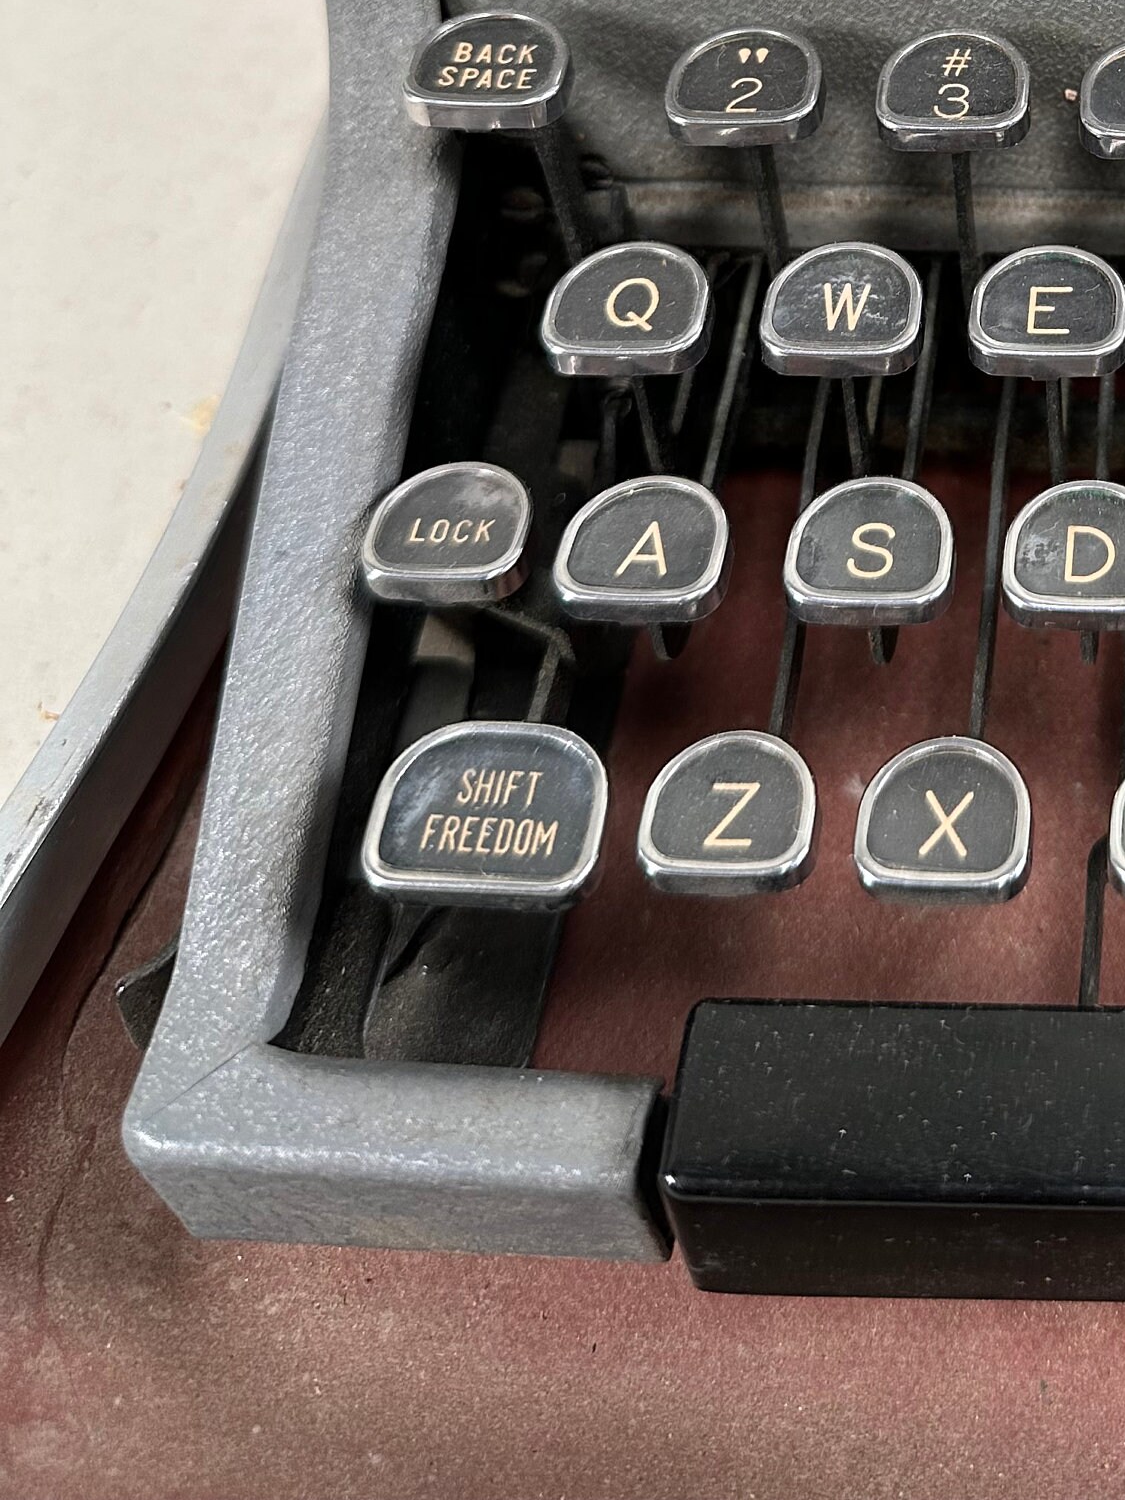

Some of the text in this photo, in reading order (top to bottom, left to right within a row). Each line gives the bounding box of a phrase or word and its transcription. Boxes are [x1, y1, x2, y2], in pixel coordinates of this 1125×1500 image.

[454, 42, 539, 65] BACK
[942, 48, 973, 76] #
[436, 66, 534, 91] SPACE
[724, 77, 764, 114] 2
[932, 83, 971, 120] 3
[604, 277, 661, 332] Q
[822, 282, 872, 332] W
[1025, 285, 1074, 335] E
[408, 517, 497, 545] LOCK
[613, 521, 669, 578] A
[845, 522, 897, 579] S
[1063, 524, 1116, 584] D
[455, 768, 544, 810] SHIFT
[420, 813, 559, 858] FREEDOM
[702, 781, 762, 848] Z
[917, 788, 975, 858] X
